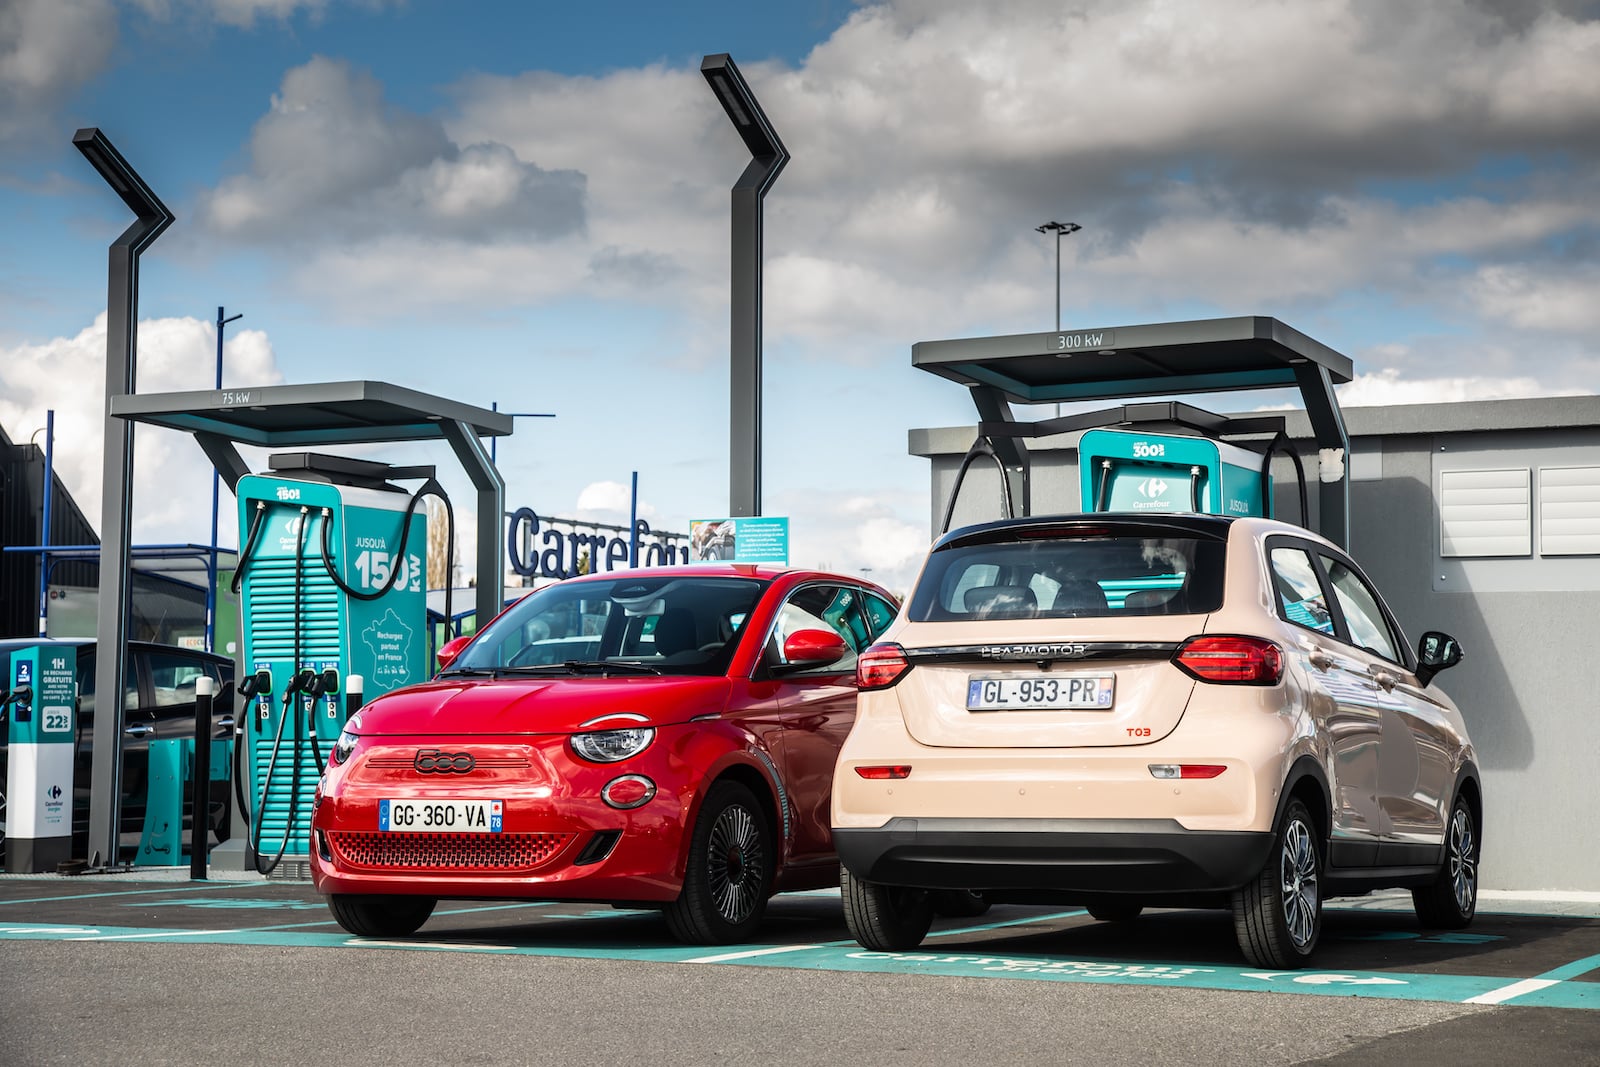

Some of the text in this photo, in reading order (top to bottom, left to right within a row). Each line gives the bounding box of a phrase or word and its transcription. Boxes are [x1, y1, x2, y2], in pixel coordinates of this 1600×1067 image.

[1058, 333, 1103, 349] 300 kW
[222, 391, 250, 404] 75 kW
[1133, 444, 1159, 457] 300
[276, 489, 296, 500] 150
[1132, 500, 1170, 508] Carrefour
[355, 537, 387, 549] JUSQU'À
[508, 507, 689, 578] Carrefou
[355, 550, 421, 592] 150 kW
[385, 653, 402, 661] France
[21, 664, 28, 674] 2
[51, 658, 65, 669] 1H
[43, 676, 73, 684] GRATUITE
[984, 680, 1096, 703] GL-953-PR
[1099, 692, 1112, 703] 31
[46, 715, 62, 729] 22
[1126, 728, 1151, 737] T03
[414, 749, 476, 773] 500
[394, 805, 486, 826] GG-360-VA
[491, 817, 501, 828] 78
